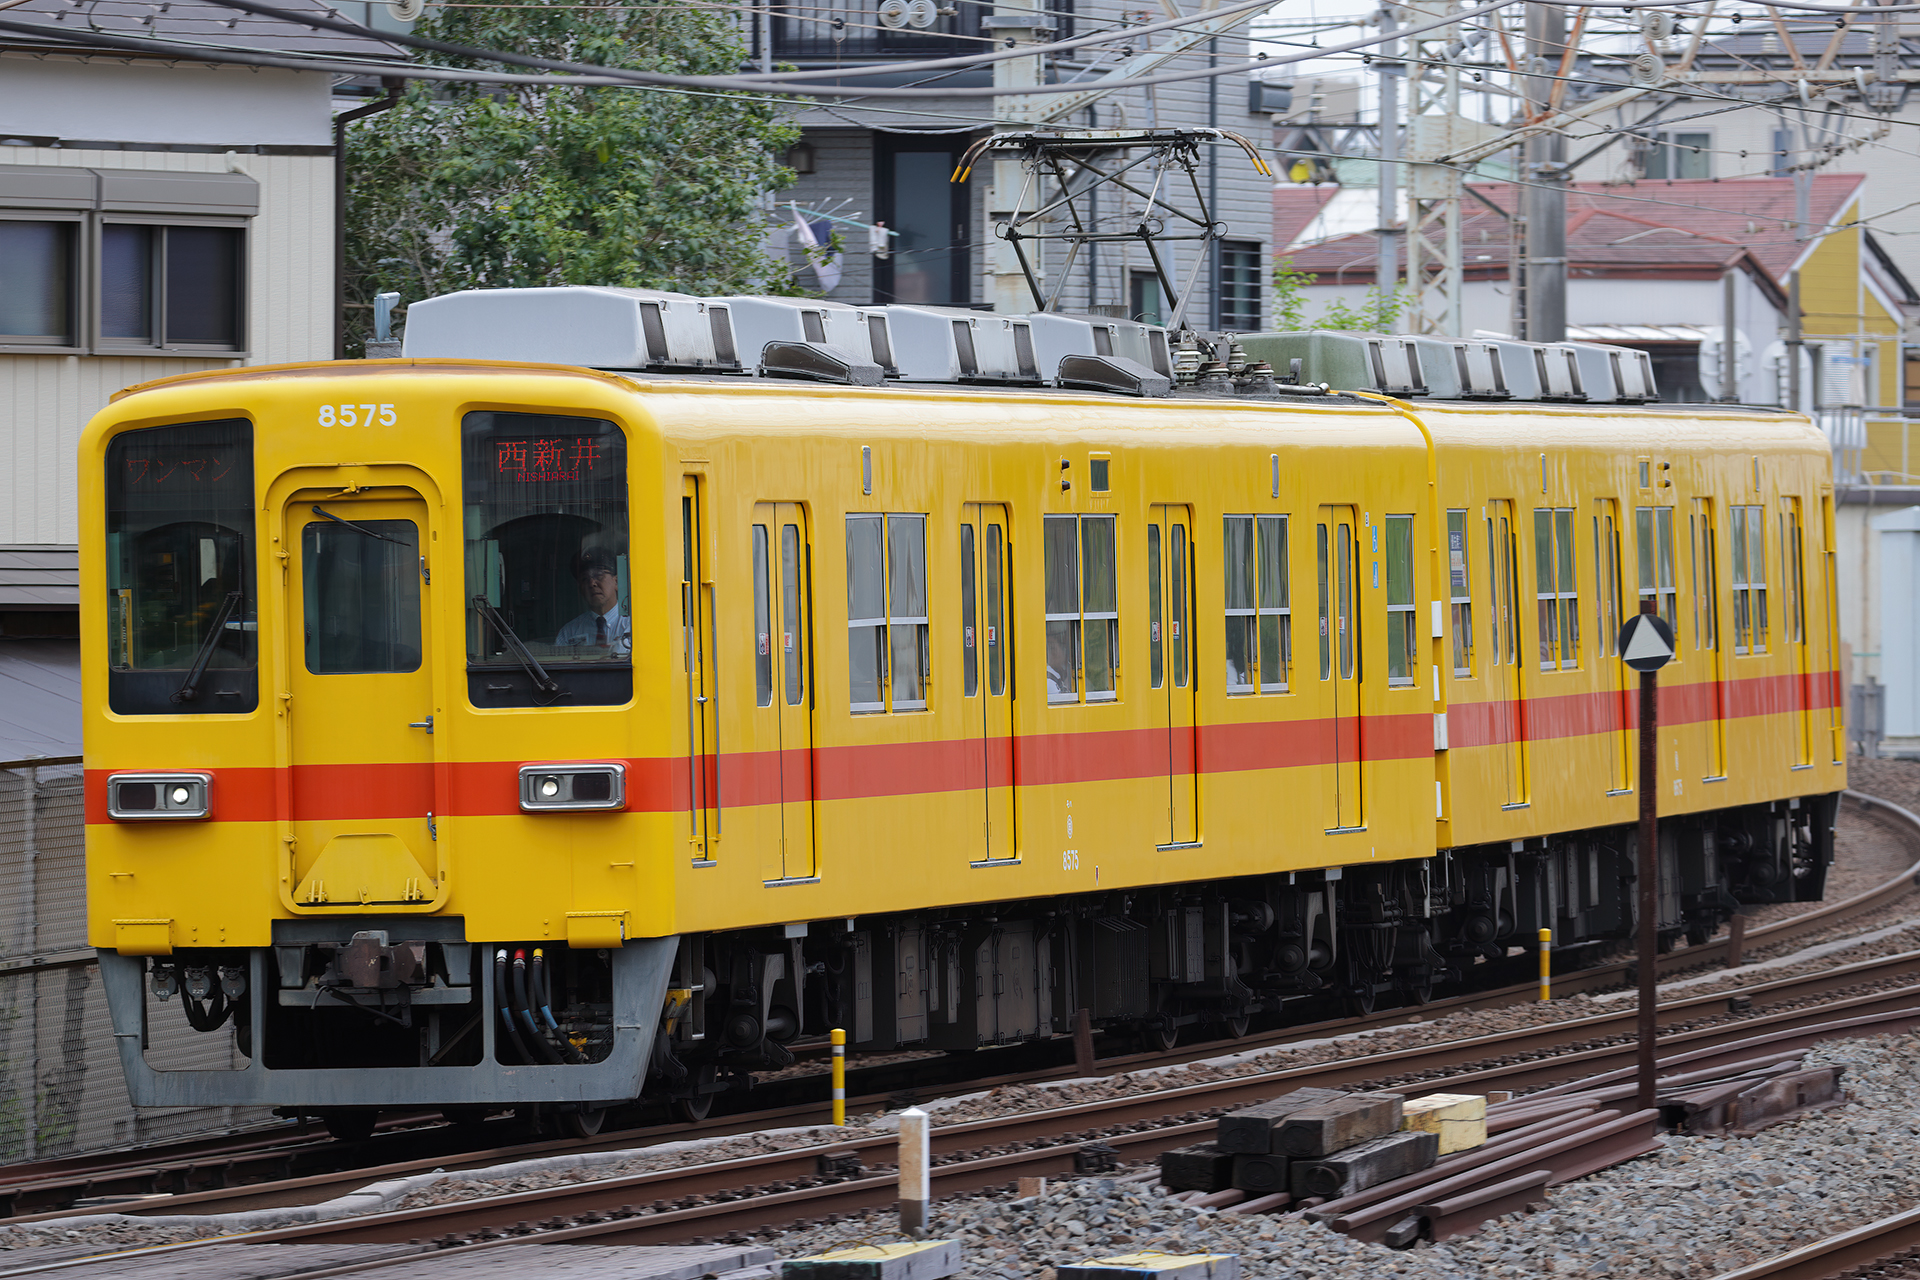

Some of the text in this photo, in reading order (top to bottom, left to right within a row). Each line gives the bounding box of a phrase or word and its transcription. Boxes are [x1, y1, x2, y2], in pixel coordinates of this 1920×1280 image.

[318, 403, 397, 428] 8575
[496, 437, 601, 472] 西新井
[126, 457, 236, 485] ワンマン
[517, 470, 580, 482] NISHIARAI
[1062, 849, 1079, 871] 8575
